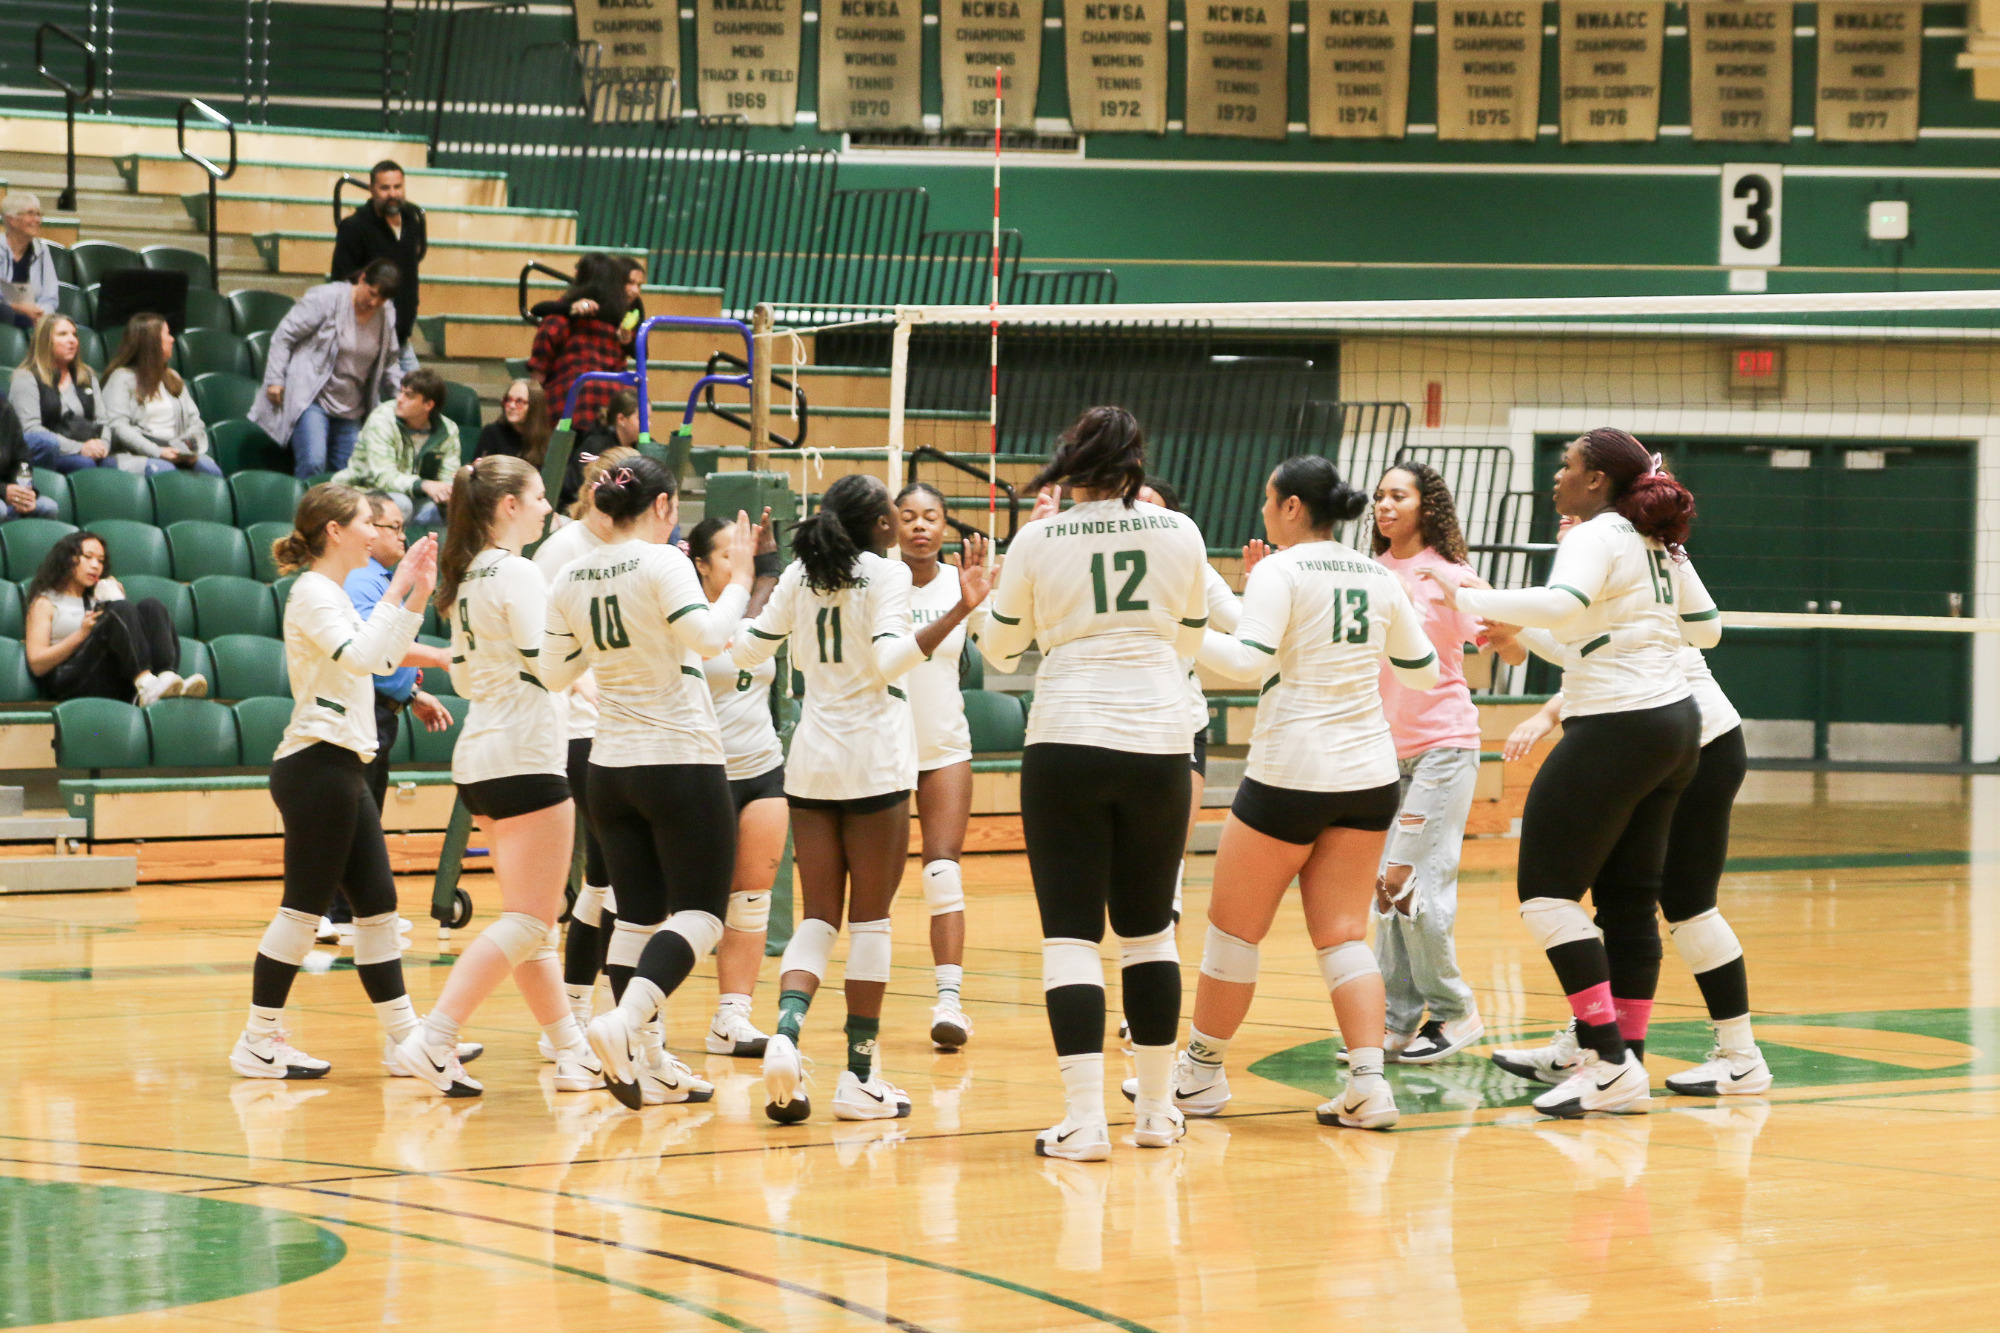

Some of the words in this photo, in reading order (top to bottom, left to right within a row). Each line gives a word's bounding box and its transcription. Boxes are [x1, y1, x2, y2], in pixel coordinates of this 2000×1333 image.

[841, 1, 900, 18] NCWSA
[960, 1, 1020, 19] NCWSA
[1085, 4, 1146, 21] NCWSA
[1207, 5, 1267, 24] NCWSA
[1329, 9, 1390, 26] NCWSA
[592, 19, 663, 33] CHAMPIONS
[1453, 11, 1526, 28] NWAACC
[1575, 12, 1647, 29] NWAACC
[1704, 12, 1776, 29] NWAACC
[713, 22, 784, 36] CHAMPIONS
[835, 27, 906, 42] CHAMPIONS
[956, 27, 1025, 42] CHAMPIONS
[1081, 30, 1152, 45] CHAMPIONS
[1203, 31, 1272, 48] CHAMPIONS
[1324, 35, 1395, 50] CHAMPIONS
[1452, 38, 1525, 52] CHAMPIONS
[1575, 39, 1647, 53] CHAMPIONS
[1705, 40, 1776, 54] CHAMPIONS
[1833, 41, 1905, 55] CHAMPIONS
[613, 42, 647, 56] MENS
[731, 45, 764, 58] MENS
[844, 52, 897, 66] WOMENS
[965, 52, 1015, 66] WOMENS
[1091, 54, 1144, 68] WOMENS
[1212, 56, 1263, 71] WOMENS
[1334, 60, 1385, 73] WOMENS
[701, 68, 739, 81] TRACK
[746, 69, 755, 82] &
[760, 69, 794, 82] FIELD
[1463, 61, 1516, 75] WOMENS
[1715, 63, 1767, 77] WOMENS
[848, 75, 894, 90] TENNIS
[1096, 77, 1142, 91] TENNIS
[727, 92, 767, 109] 1969
[851, 99, 891, 116] 1970
[1101, 100, 1141, 117] 1972
[1338, 105, 1379, 123] 1974
[1468, 108, 1511, 126] 1975
[1733, 173, 1772, 250] 3
[1739, 350, 1774, 377] EXIT
[1045, 516, 1179, 538] THUNDERBIRDS
[1296, 559, 1388, 577] THUNDERBIRDS
[1090, 550, 1149, 614] 12
[1646, 549, 1674, 605] 15
[459, 597, 476, 651] 9
[589, 594, 631, 650] 10
[1332, 588, 1370, 644] 13
[815, 606, 843, 663] 11
